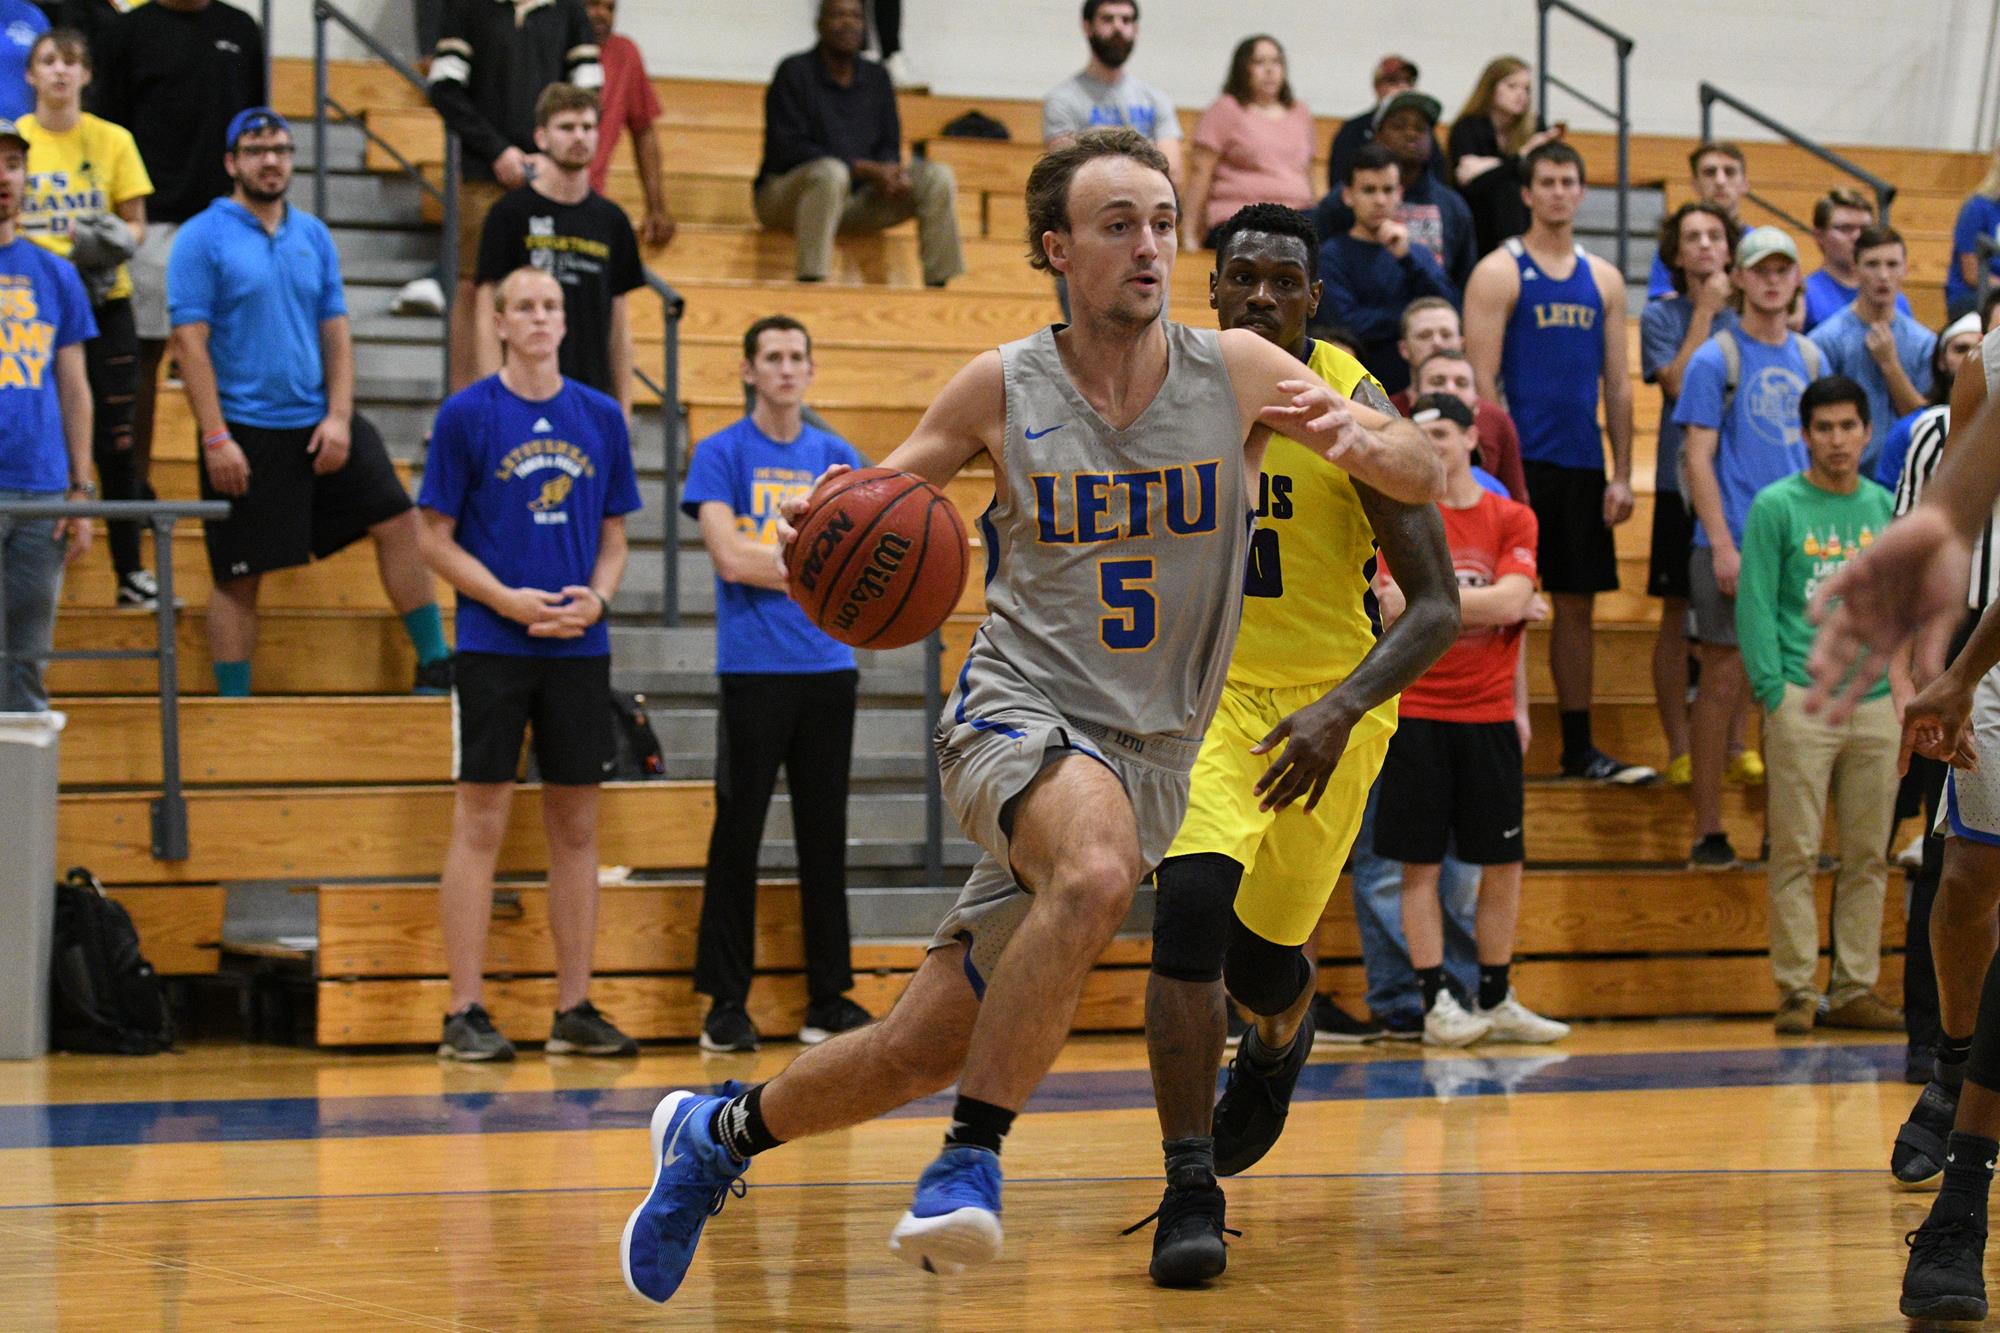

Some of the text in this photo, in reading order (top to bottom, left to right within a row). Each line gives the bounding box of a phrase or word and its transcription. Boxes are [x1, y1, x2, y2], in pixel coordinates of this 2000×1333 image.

[1534, 303, 1596, 331] LETU
[0, 353, 46, 389] AY
[1029, 458, 1222, 547] LETU
[799, 509, 855, 592] NCAA
[832, 531, 912, 630] Wilson
[1098, 556, 1160, 653] 5
[1116, 730, 1146, 754] LETU
